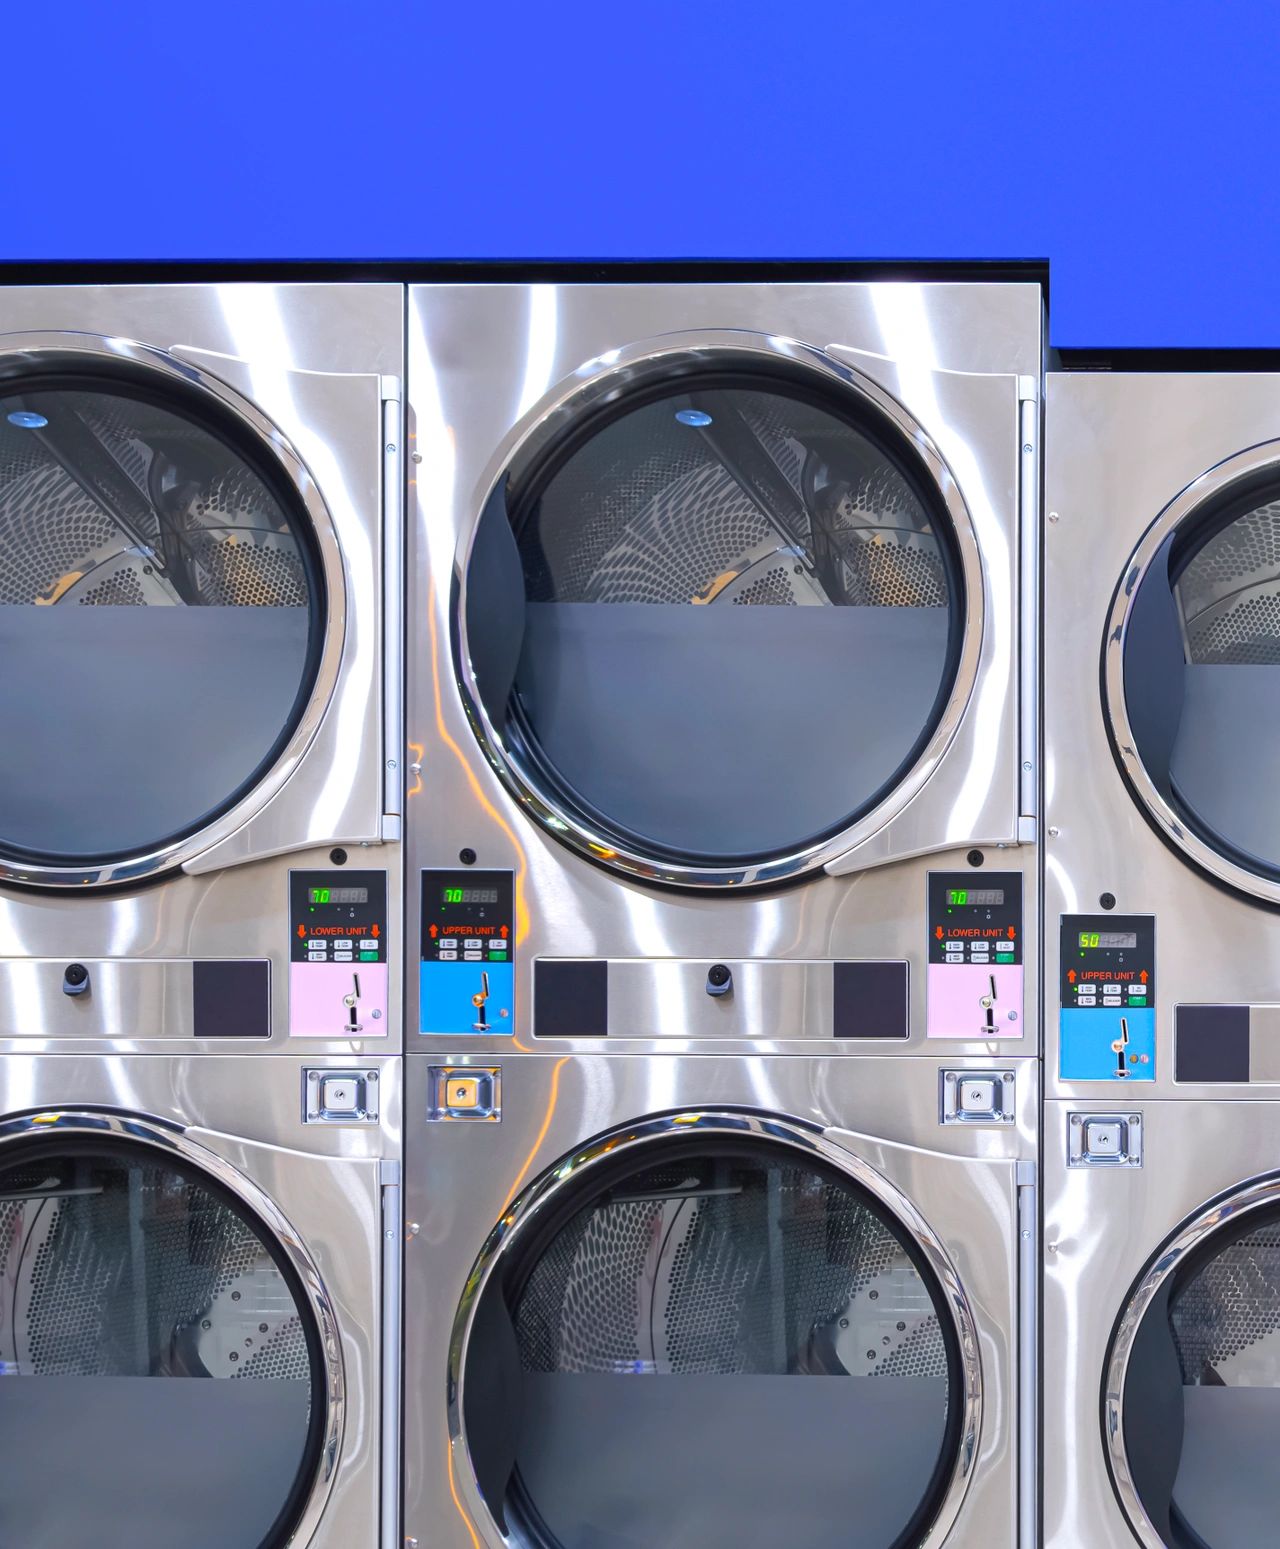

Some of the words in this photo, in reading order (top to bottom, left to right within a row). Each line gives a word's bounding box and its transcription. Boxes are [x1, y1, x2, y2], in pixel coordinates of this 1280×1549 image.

[312, 890, 330, 903] 70
[445, 889, 463, 903] 70
[950, 892, 967, 905] 70
[310, 927, 344, 935] LOWER
[346, 927, 367, 935] UNIT
[442, 927, 473, 935] UPPER
[475, 927, 496, 935] UNIT
[947, 929, 980, 937] LOWER
[982, 929, 1004, 937] UNIT
[1081, 934, 1099, 948] 50
[1081, 972, 1112, 980] UPPER
[1114, 972, 1135, 980] UNIT
